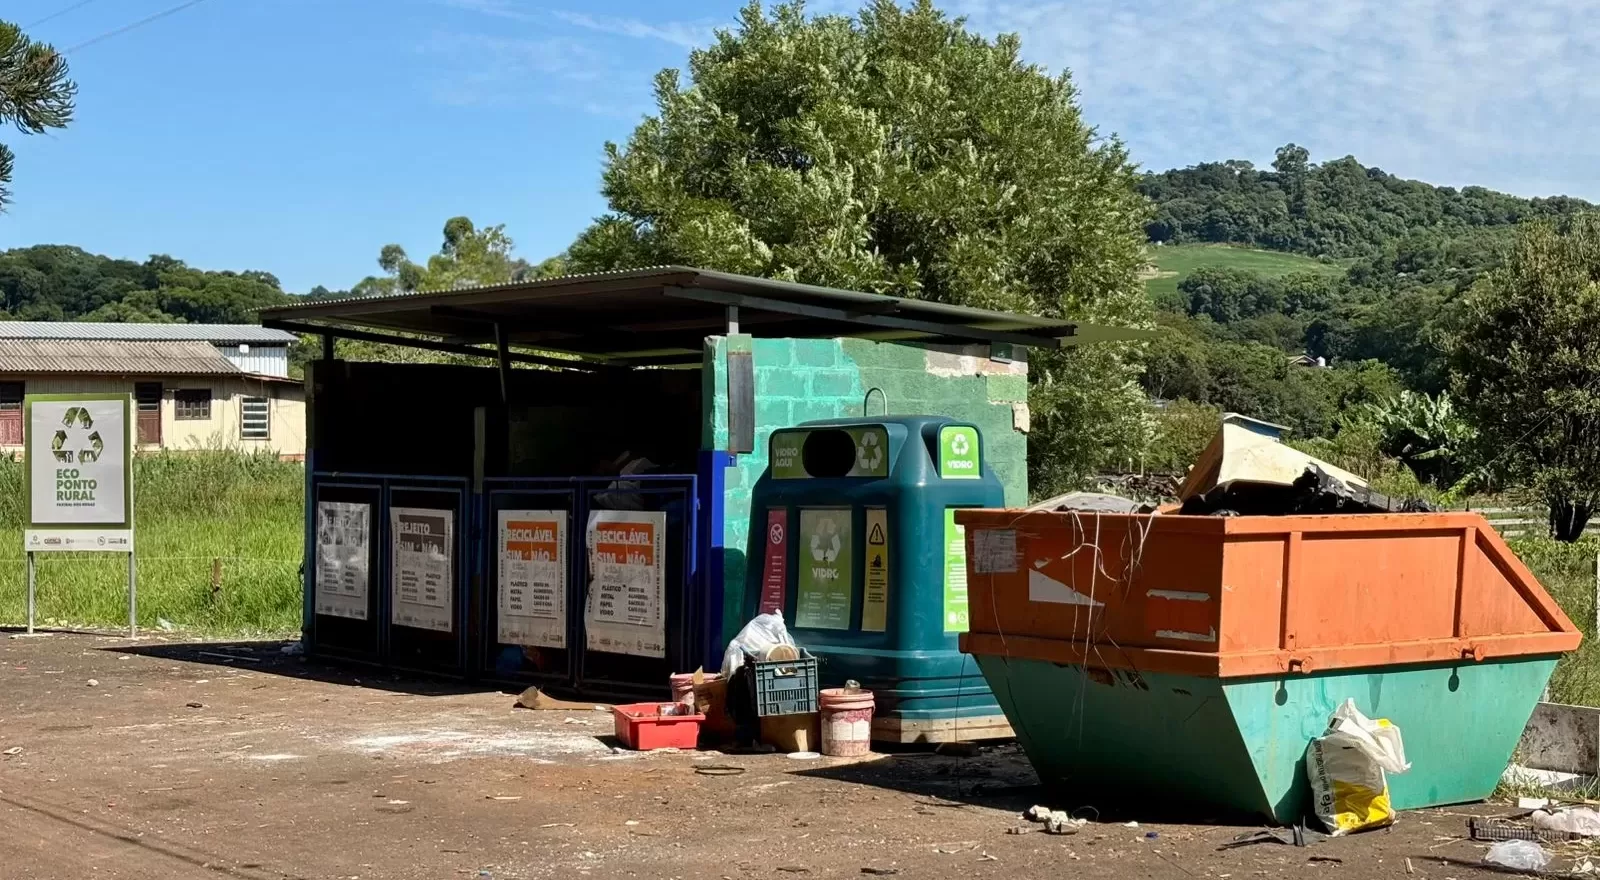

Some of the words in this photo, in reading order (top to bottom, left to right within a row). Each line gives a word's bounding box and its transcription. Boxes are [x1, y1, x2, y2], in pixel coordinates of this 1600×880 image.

[775, 448, 798, 457] VIDRO
[775, 458, 793, 467] AQUI
[946, 460, 974, 469] VIDRO
[56, 469, 79, 479] ECO
[56, 480, 97, 490] PONTO
[56, 491, 95, 501] RURAL
[507, 527, 554, 543] RECICLÁVEL
[596, 528, 650, 545] RECICLÁVEL
[507, 550, 522, 561] SIM
[531, 548, 550, 563] NÃO
[597, 551, 616, 564] SIM
[626, 550, 646, 565] NÃO
[811, 567, 840, 579] VIDRO
